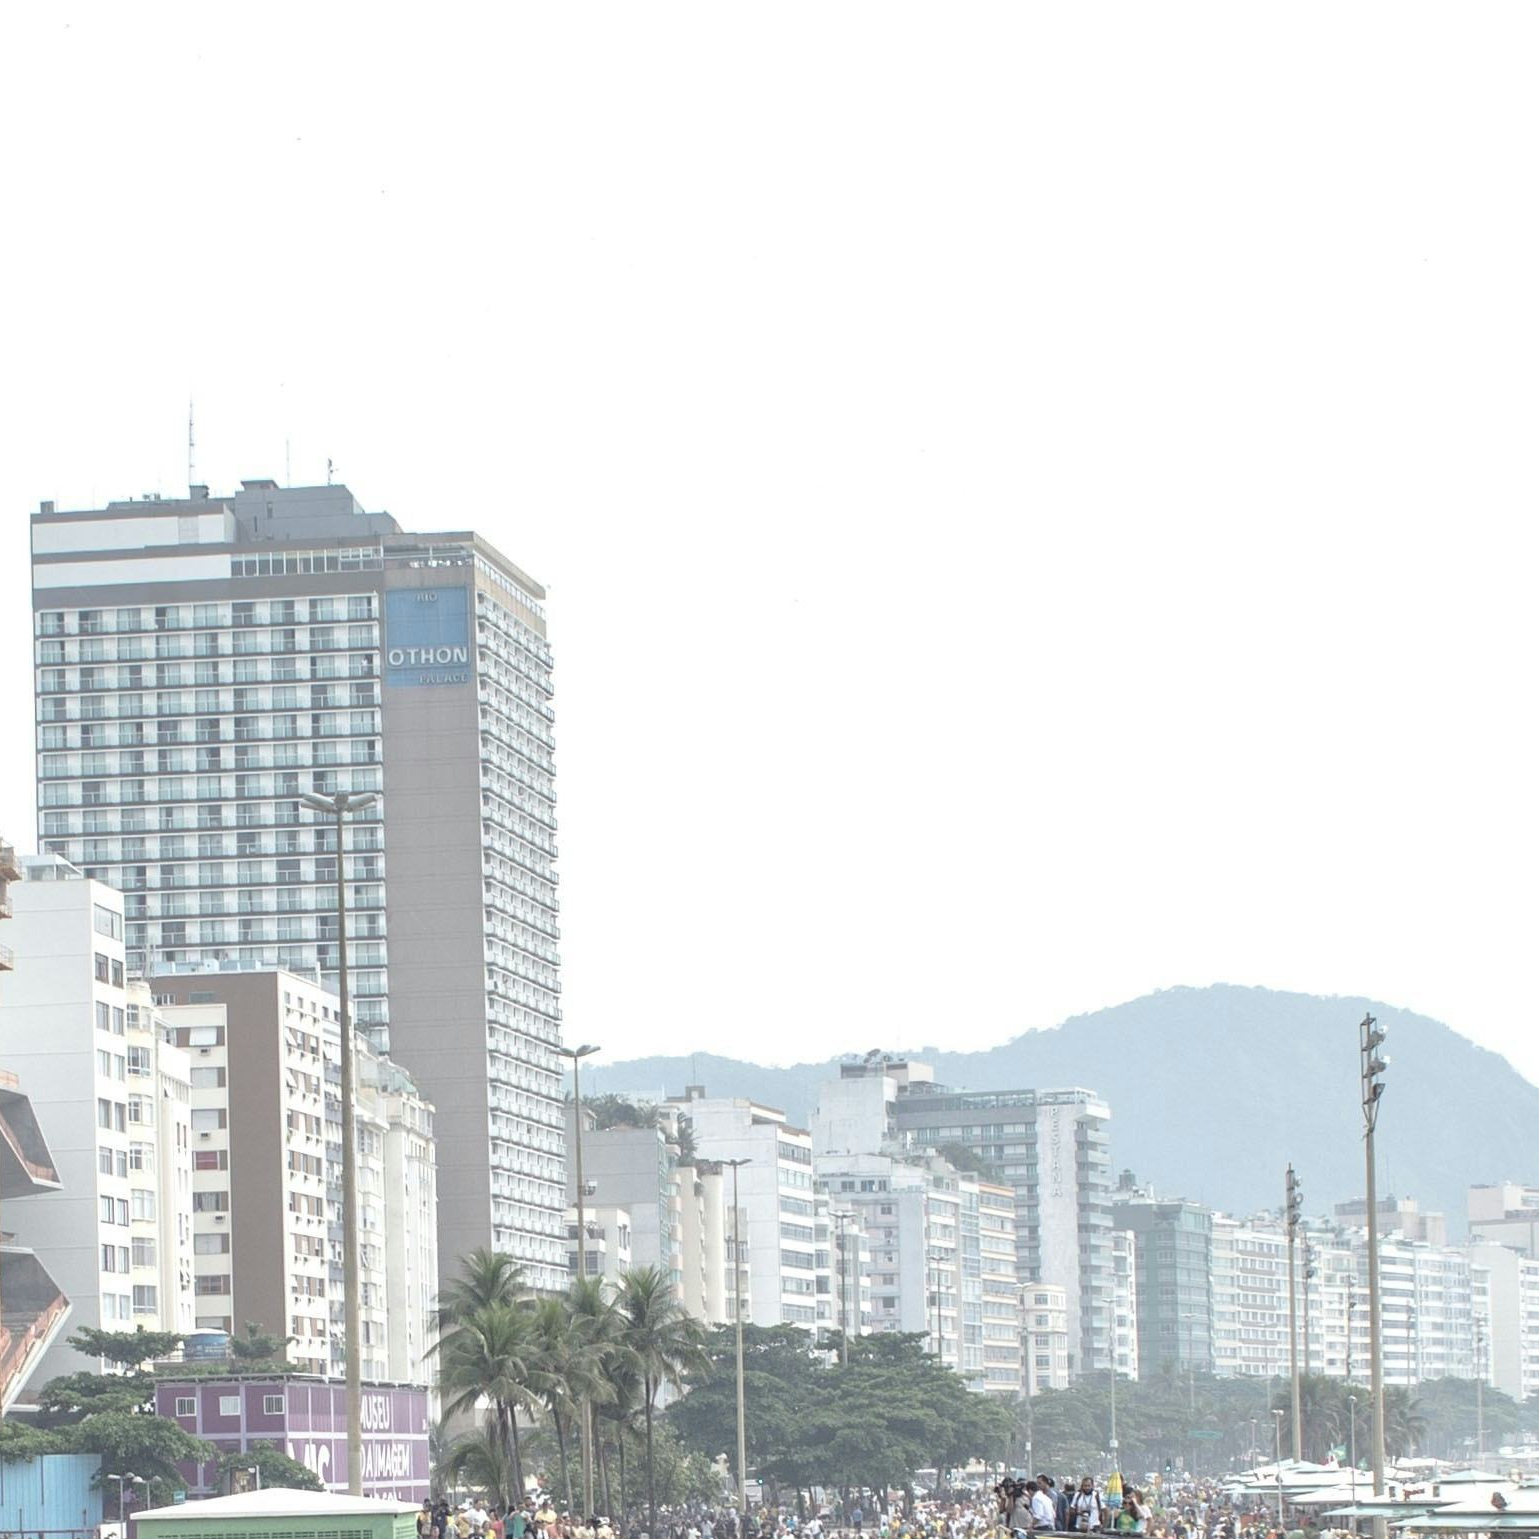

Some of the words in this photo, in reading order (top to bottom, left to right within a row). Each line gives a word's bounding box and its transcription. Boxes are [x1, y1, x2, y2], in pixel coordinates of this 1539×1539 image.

[388, 647, 469, 665] OTHON
[419, 672, 470, 684] PALACE
[375, 1444, 410, 1477] IMAGEM
